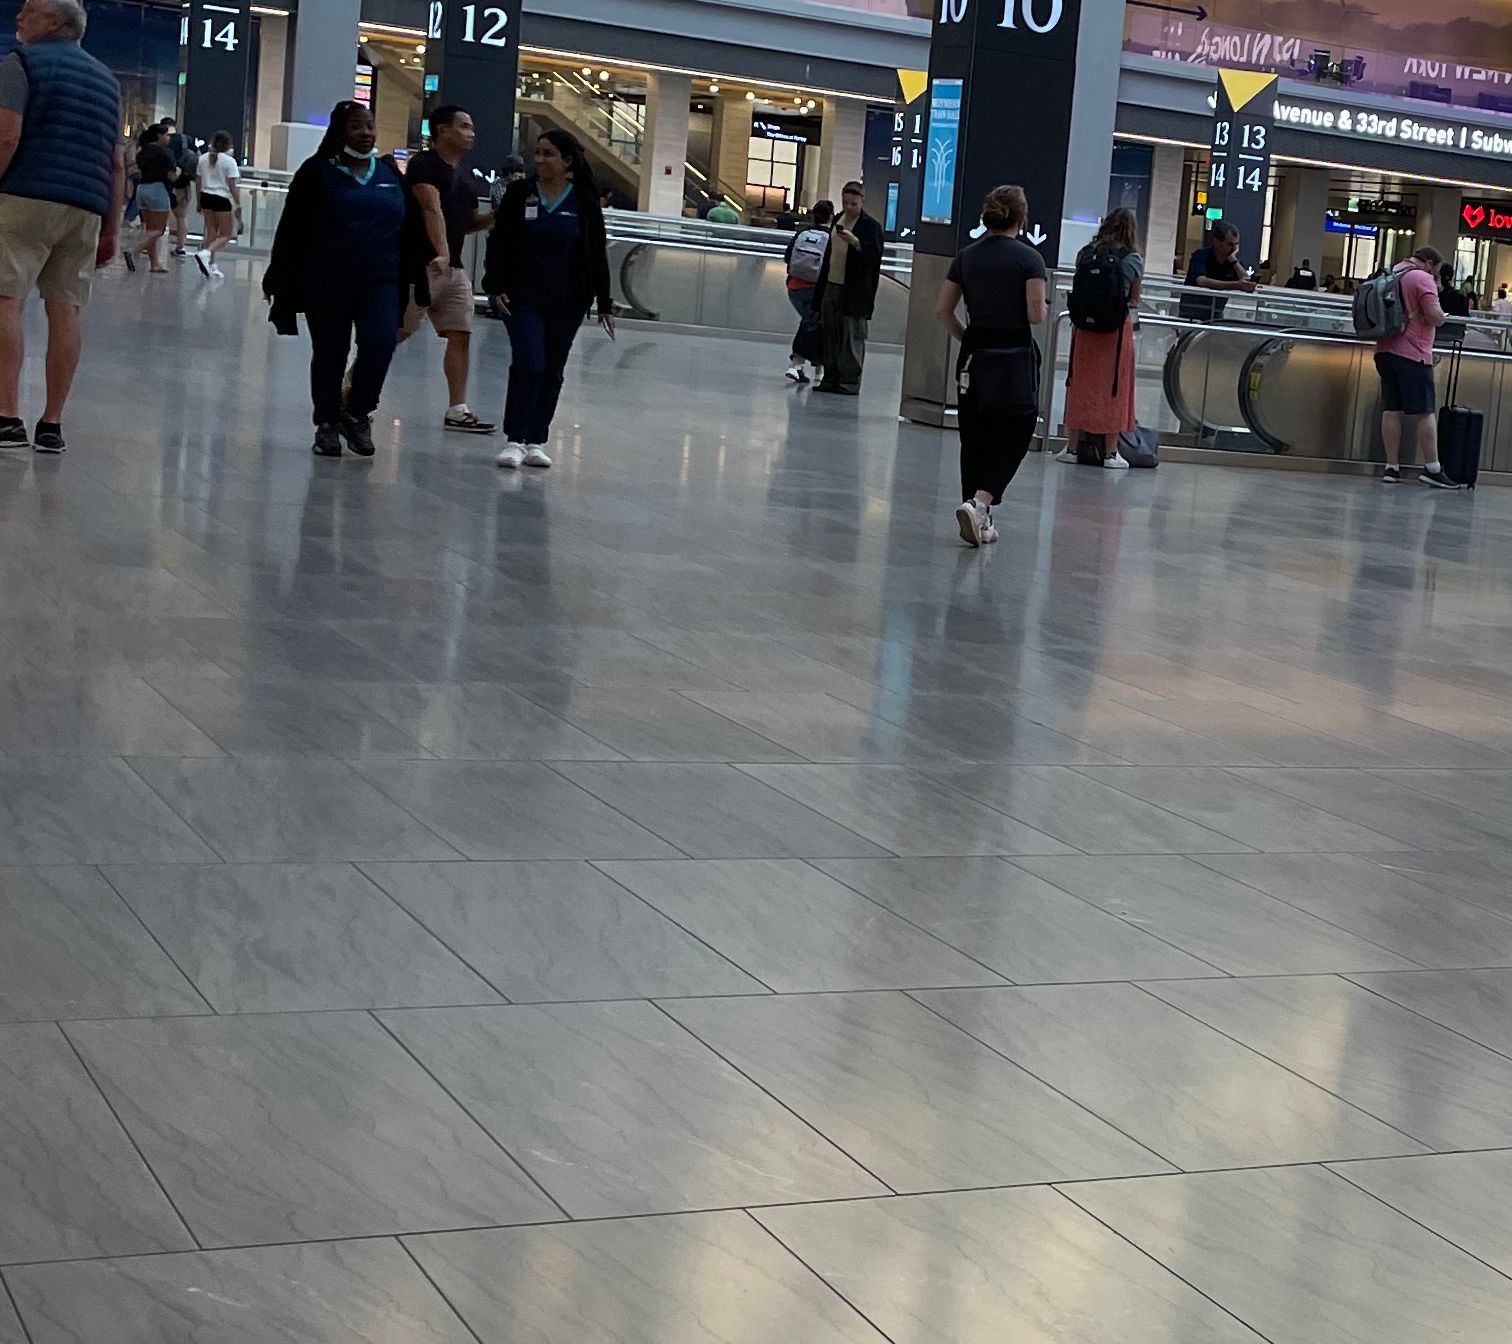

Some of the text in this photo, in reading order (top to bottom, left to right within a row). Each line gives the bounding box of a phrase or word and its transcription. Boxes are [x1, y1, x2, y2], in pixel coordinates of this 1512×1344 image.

[428, 1, 443, 38] 12
[461, 4, 508, 47] 12
[202, 19, 239, 51] 14
[1215, 121, 1230, 146] 13
[1241, 124, 1266, 150] 13
[1338, 109, 1353, 130] &
[1356, 112, 1397, 138] 33rd
[1400, 119, 1455, 146] Street
[1210, 162, 1226, 188] 14
[1236, 165, 1262, 192] 14
